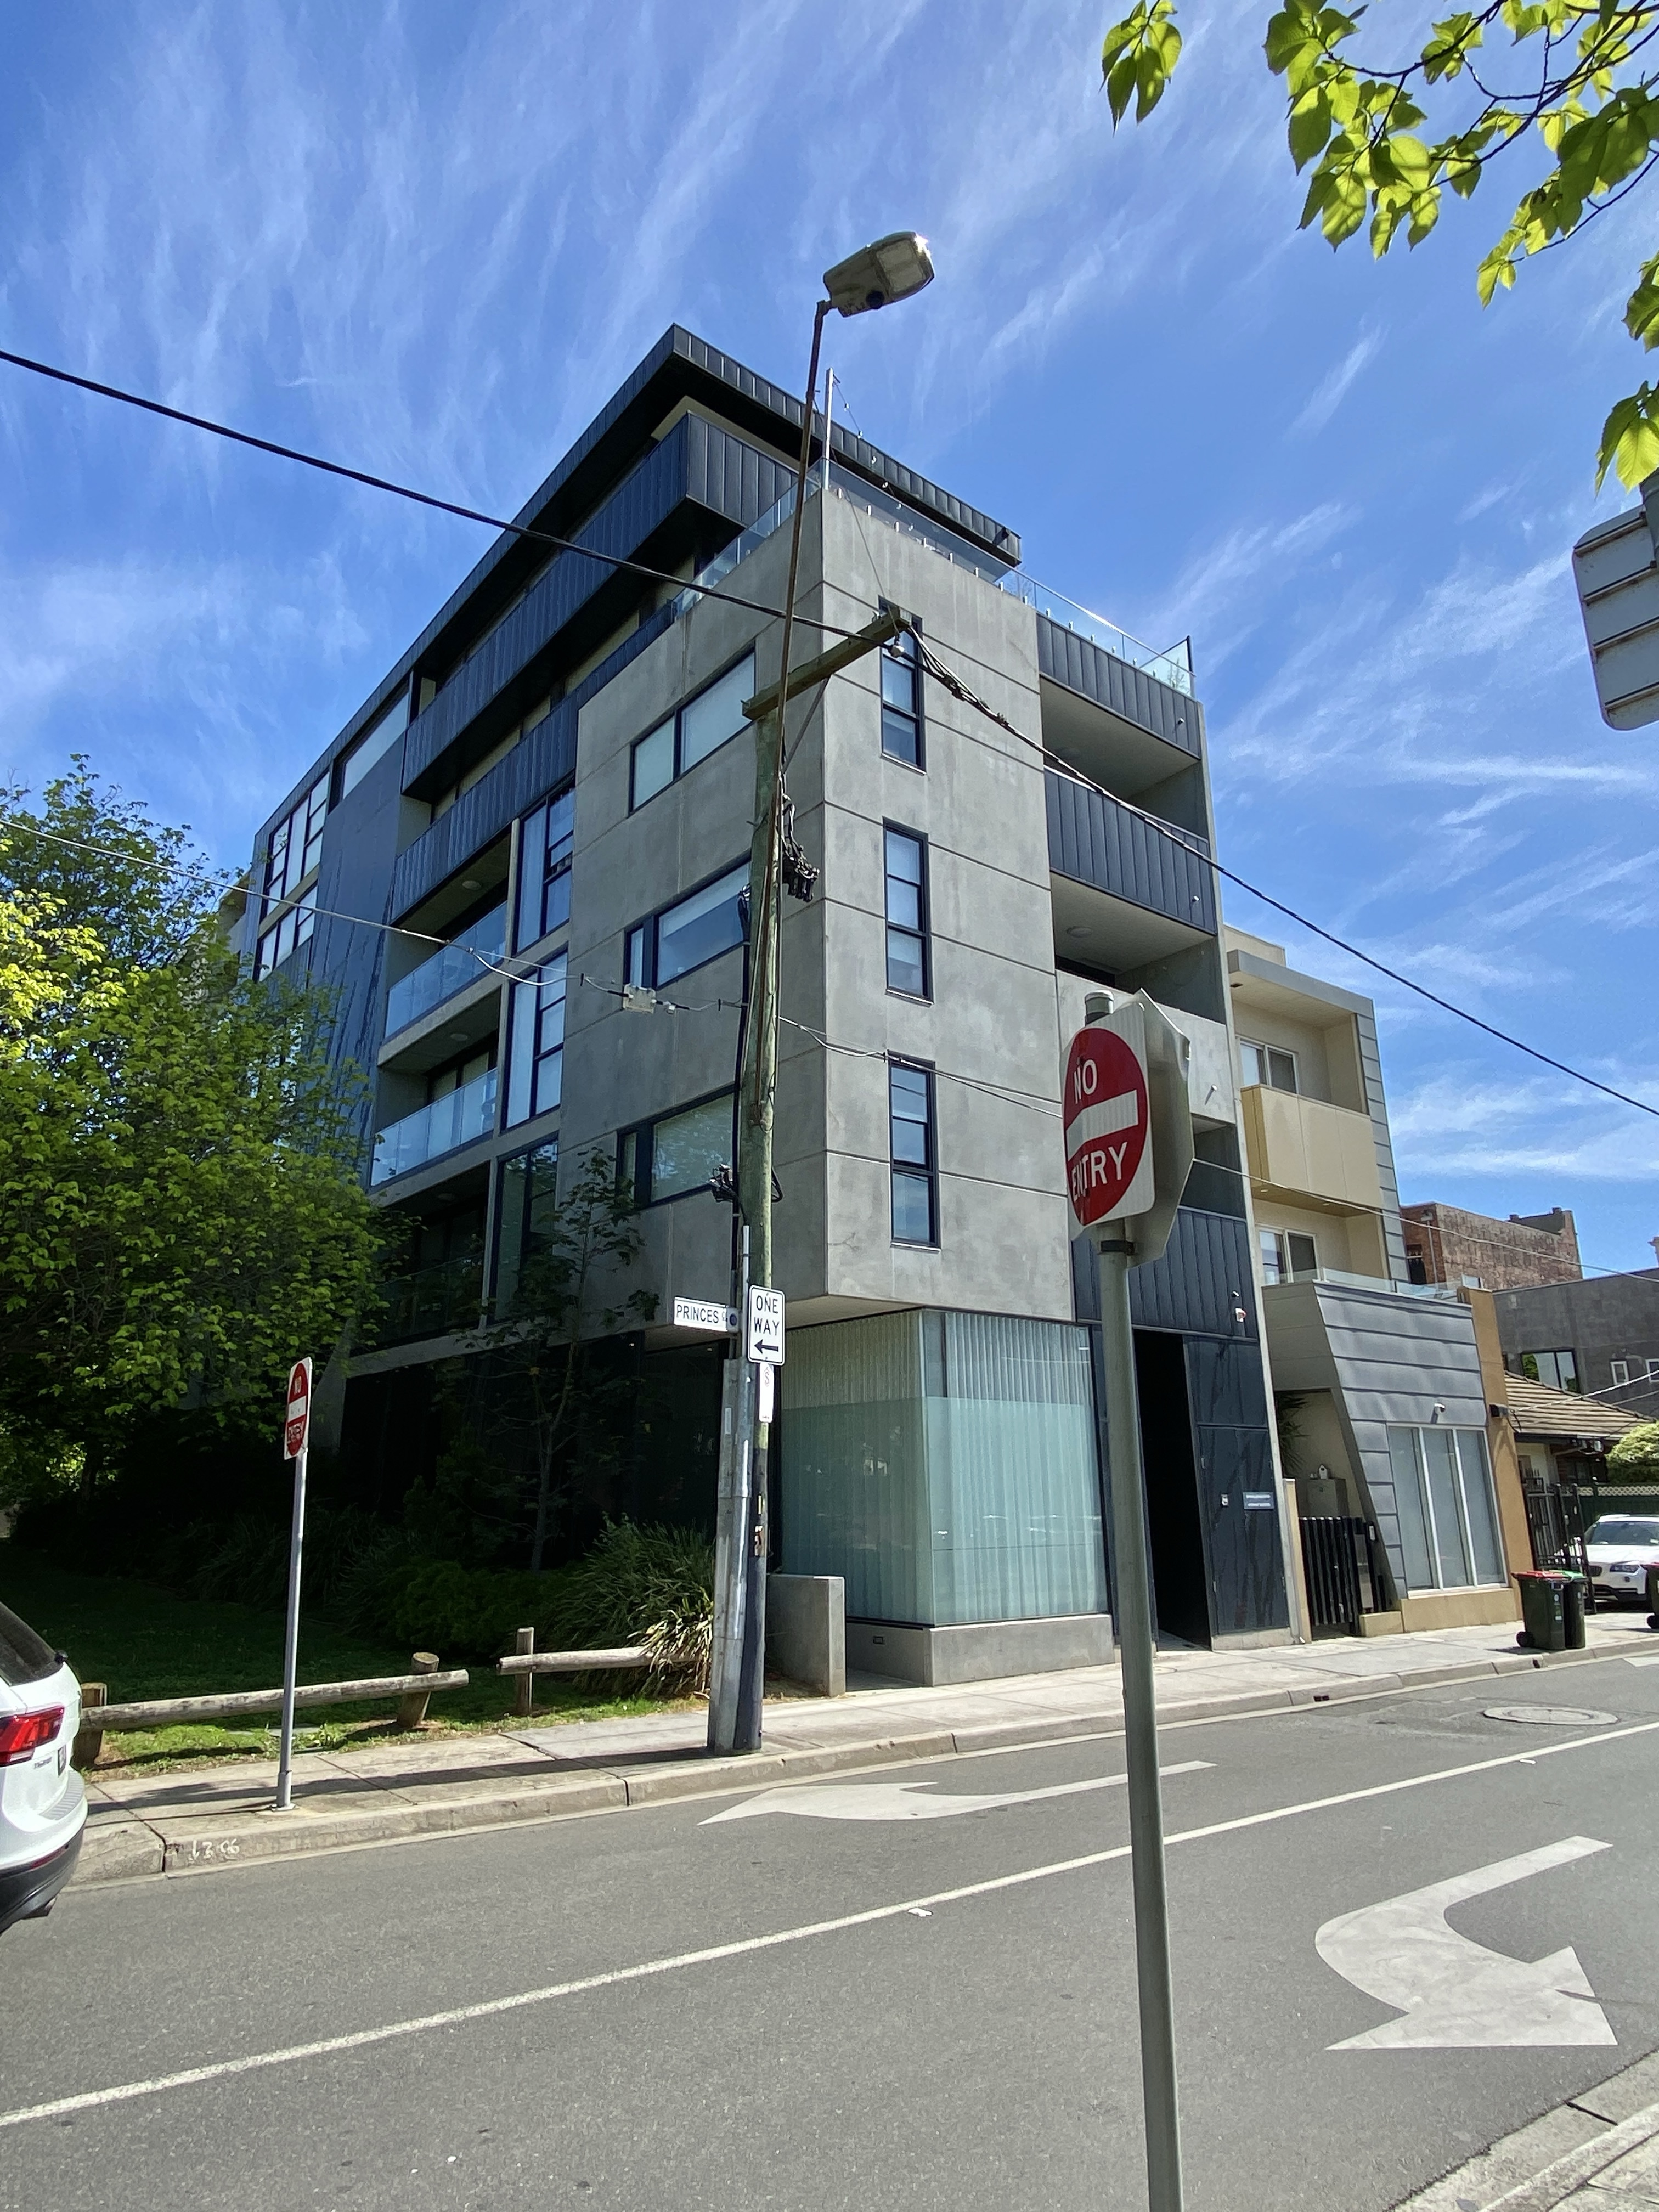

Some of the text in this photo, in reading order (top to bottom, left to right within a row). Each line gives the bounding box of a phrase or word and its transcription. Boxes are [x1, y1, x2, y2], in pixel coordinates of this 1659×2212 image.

[1074, 1059, 1097, 1104] NO
[1071, 1142, 1128, 1202] ENTRY
[676, 1305, 719, 1323] PRINCES
[756, 1295, 778, 1314] ONE
[754, 1317, 780, 1336] WAY
